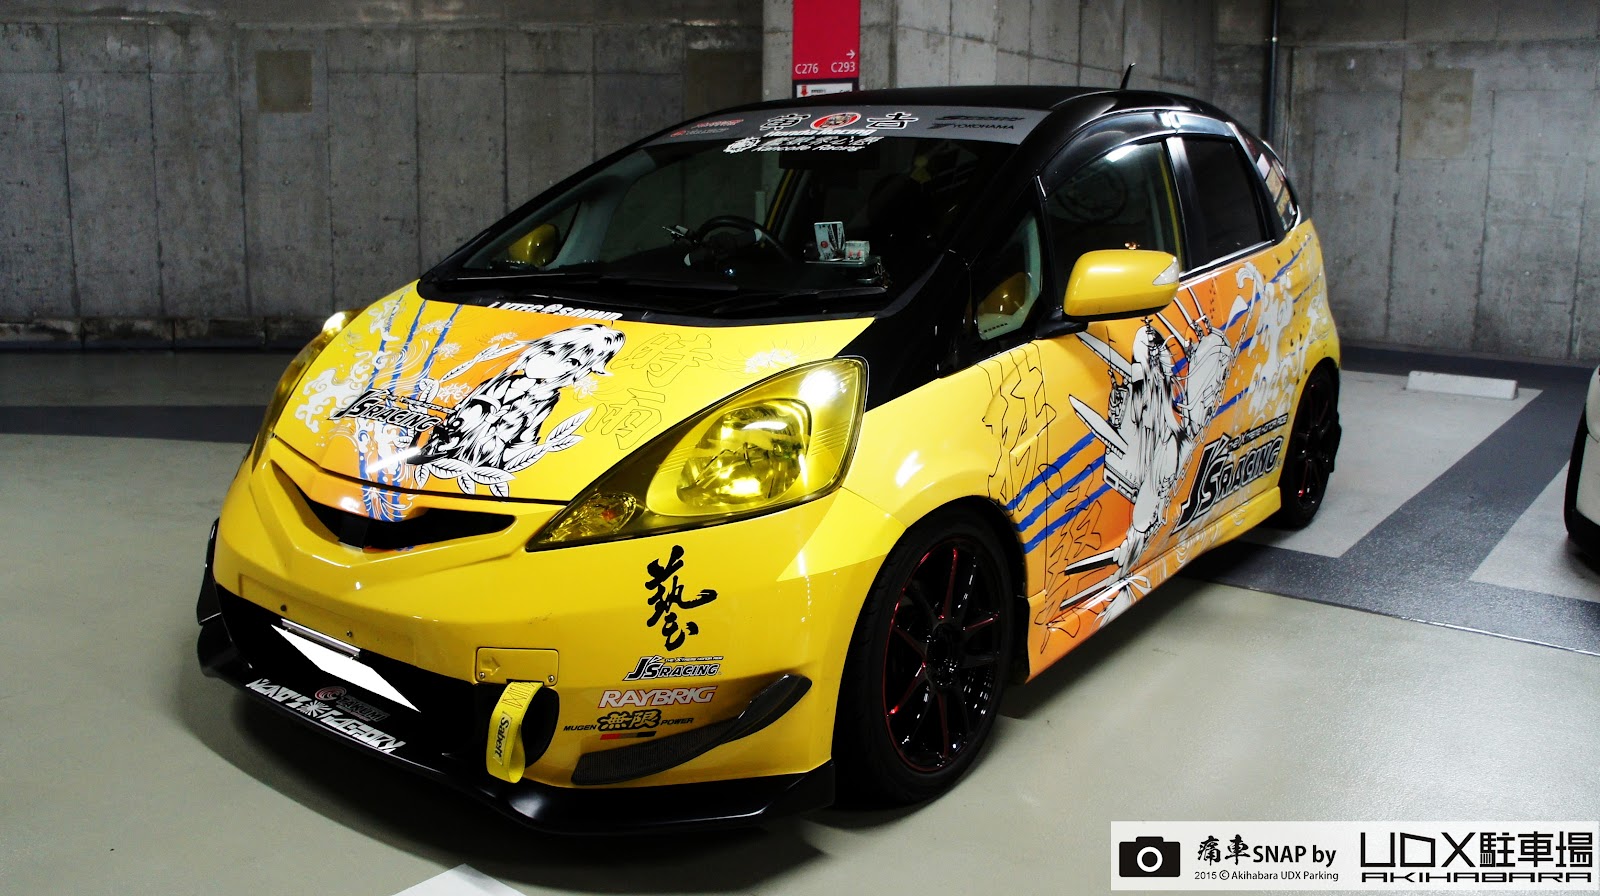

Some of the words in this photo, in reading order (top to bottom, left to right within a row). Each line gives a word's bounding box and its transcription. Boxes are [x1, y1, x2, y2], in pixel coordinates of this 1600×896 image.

[794, 63, 819, 75] C276
[830, 61, 856, 73] C293
[598, 685, 718, 709] RAYBRIG
[563, 724, 598, 732] MUGEN
[660, 717, 695, 726] POWER
